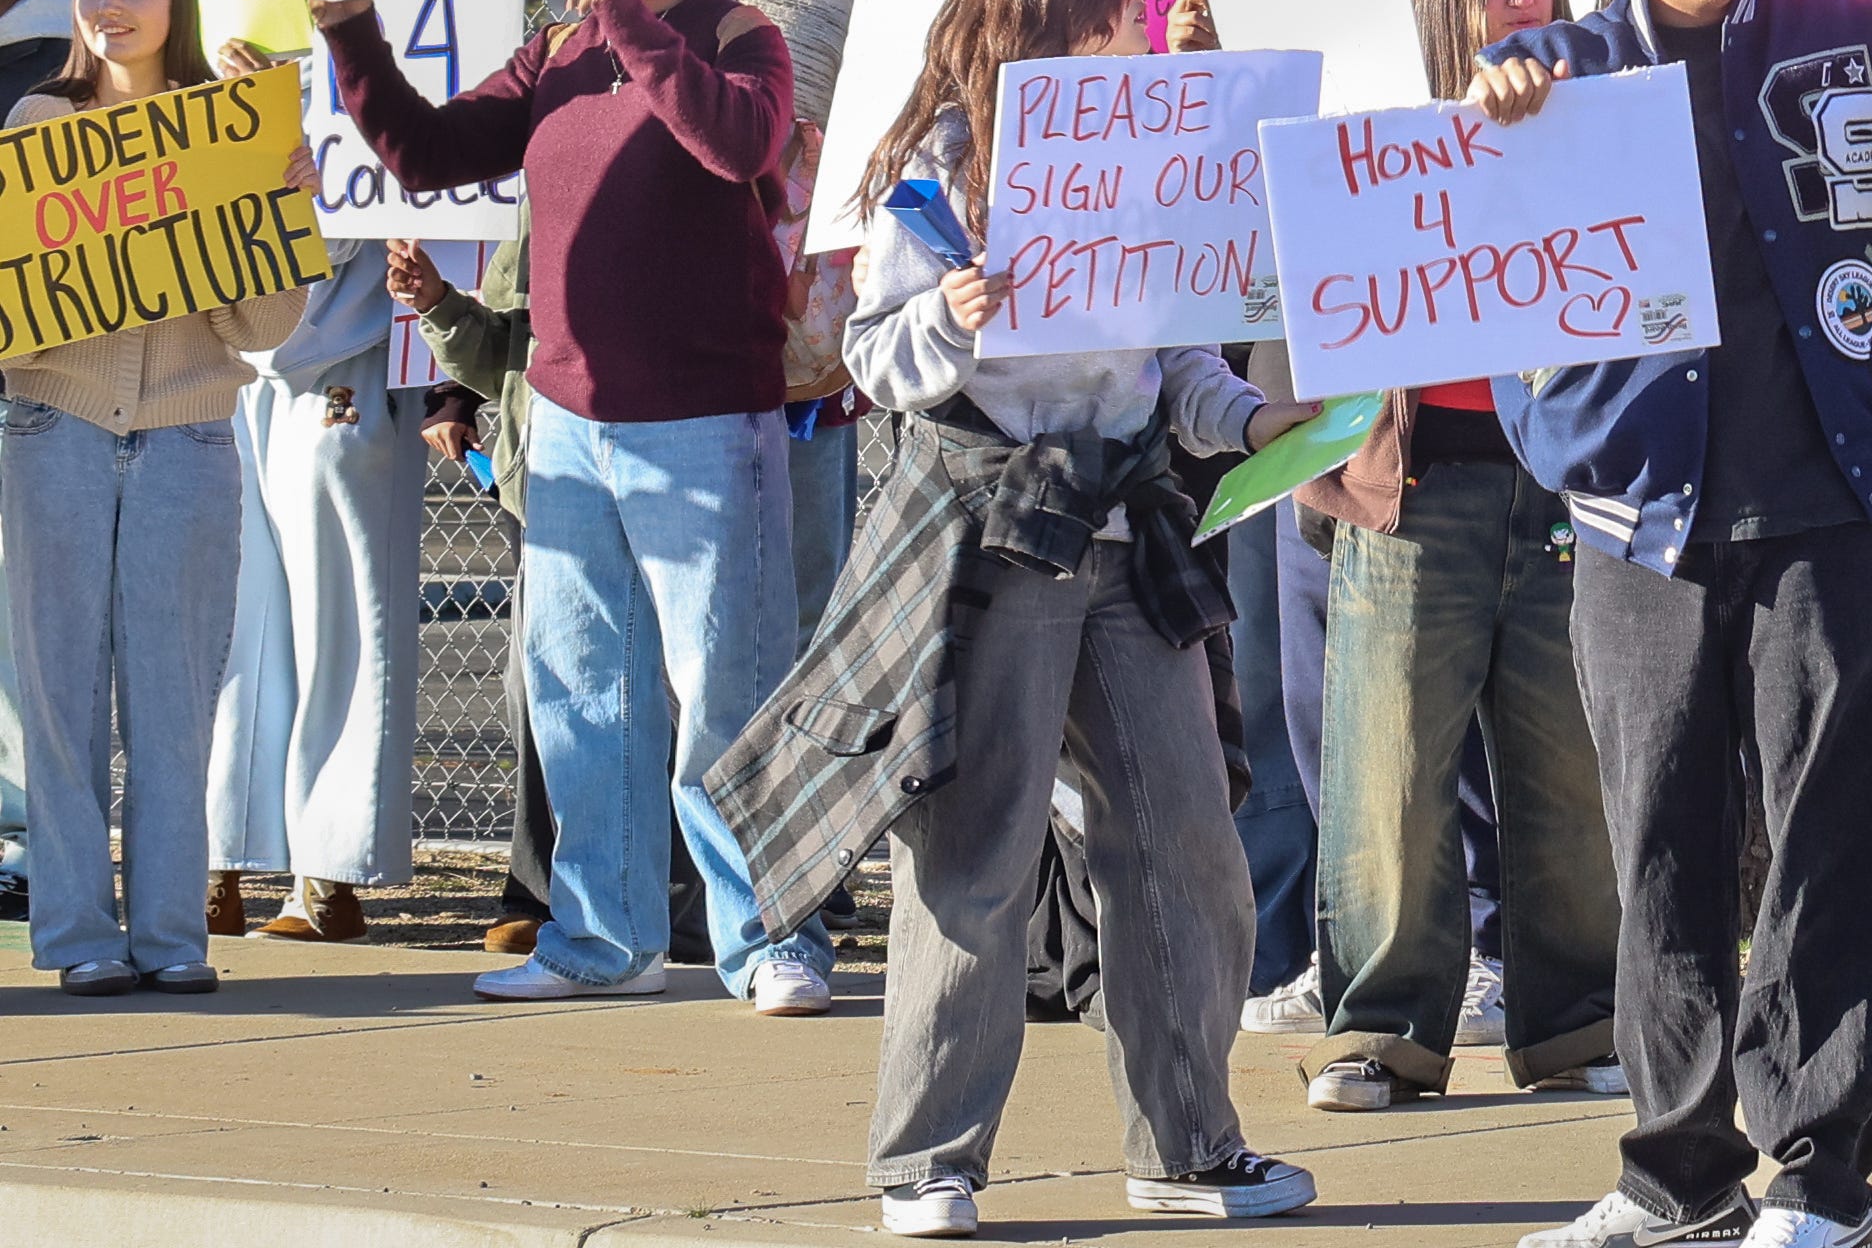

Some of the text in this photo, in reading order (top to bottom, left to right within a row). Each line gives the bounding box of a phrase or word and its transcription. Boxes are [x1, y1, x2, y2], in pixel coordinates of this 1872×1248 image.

[0, 78, 261, 199] TUDENTS
[1017, 71, 1214, 148] PLEASE
[36, 160, 189, 250] OVER
[1007, 148, 1260, 215] SIGN OUR
[1413, 189, 1457, 250] 4
[1007, 230, 1259, 331] PETITION
[1311, 215, 1646, 350] SUPPORT
